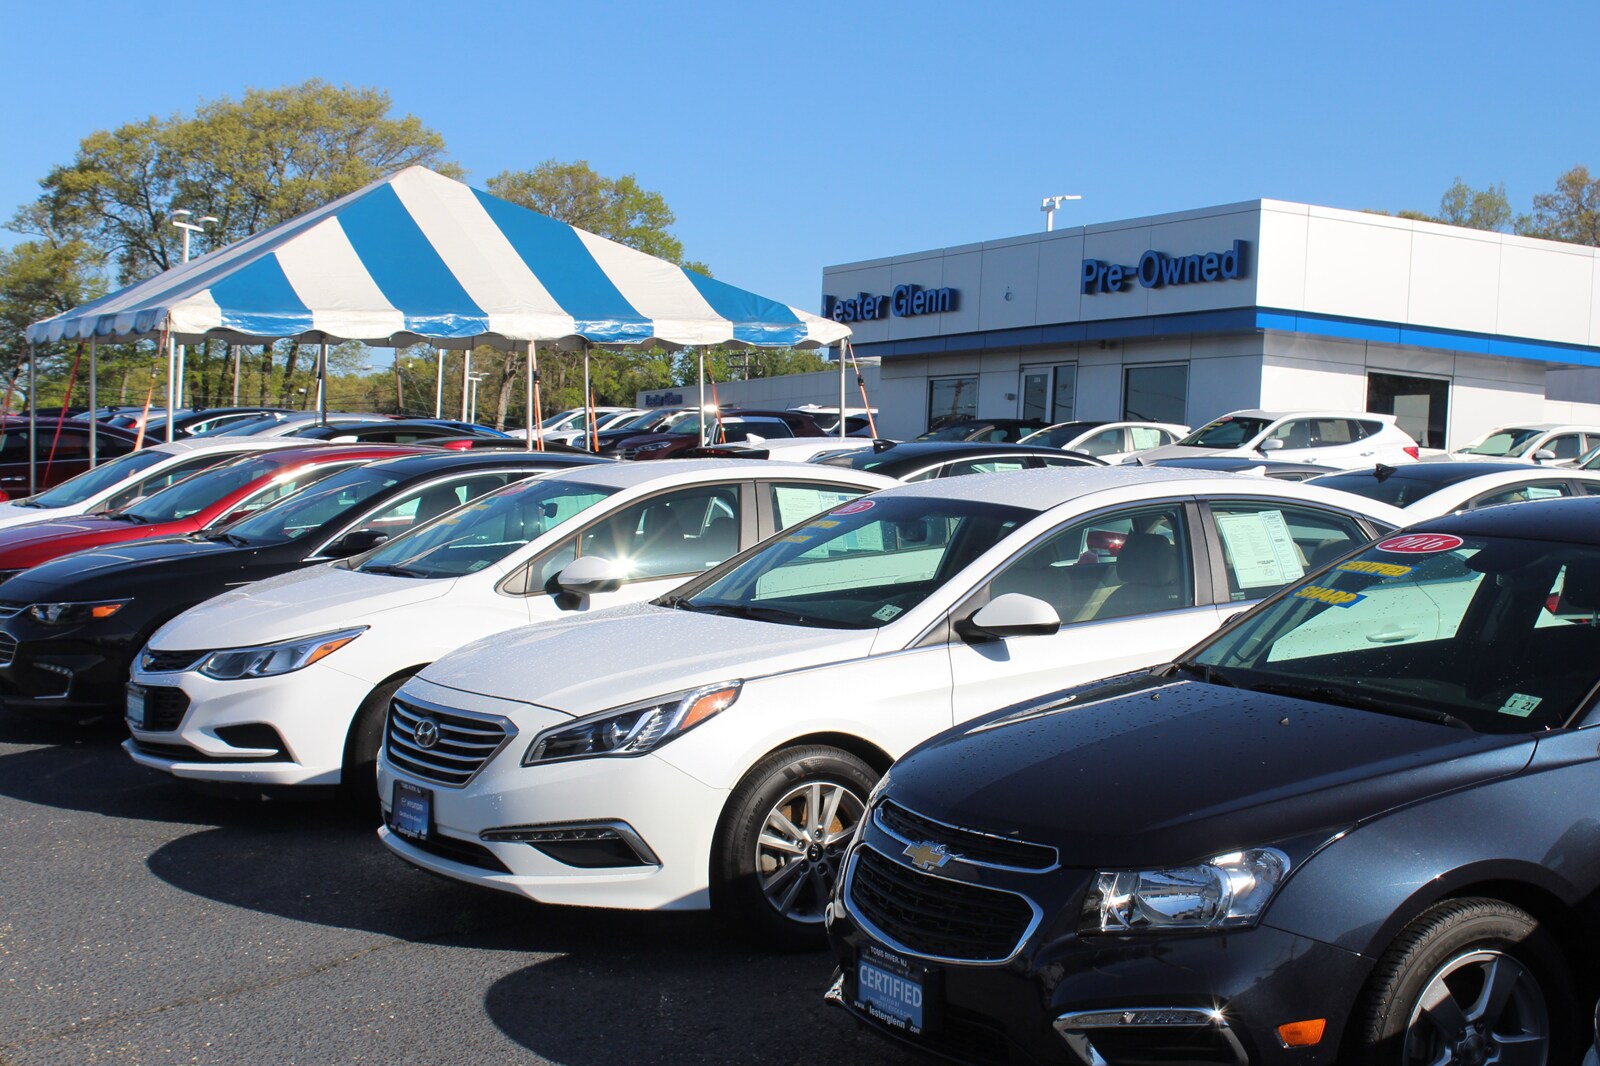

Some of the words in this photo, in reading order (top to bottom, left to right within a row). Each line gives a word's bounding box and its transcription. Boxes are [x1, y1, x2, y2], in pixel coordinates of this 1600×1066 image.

[1080, 239, 1245, 295] Pre-Owned
[823, 291, 887, 322] Lester
[891, 284, 956, 317] Glenn
[1382, 536, 1458, 551] 2016
[1336, 561, 1412, 577] CERTIFIED
[1294, 586, 1357, 604] SHARP
[1508, 700, 1518, 708] 1
[1521, 701, 1535, 711] 21
[860, 965, 922, 1008] CERTIFIED
[869, 1005, 905, 1029] lesterglenn
